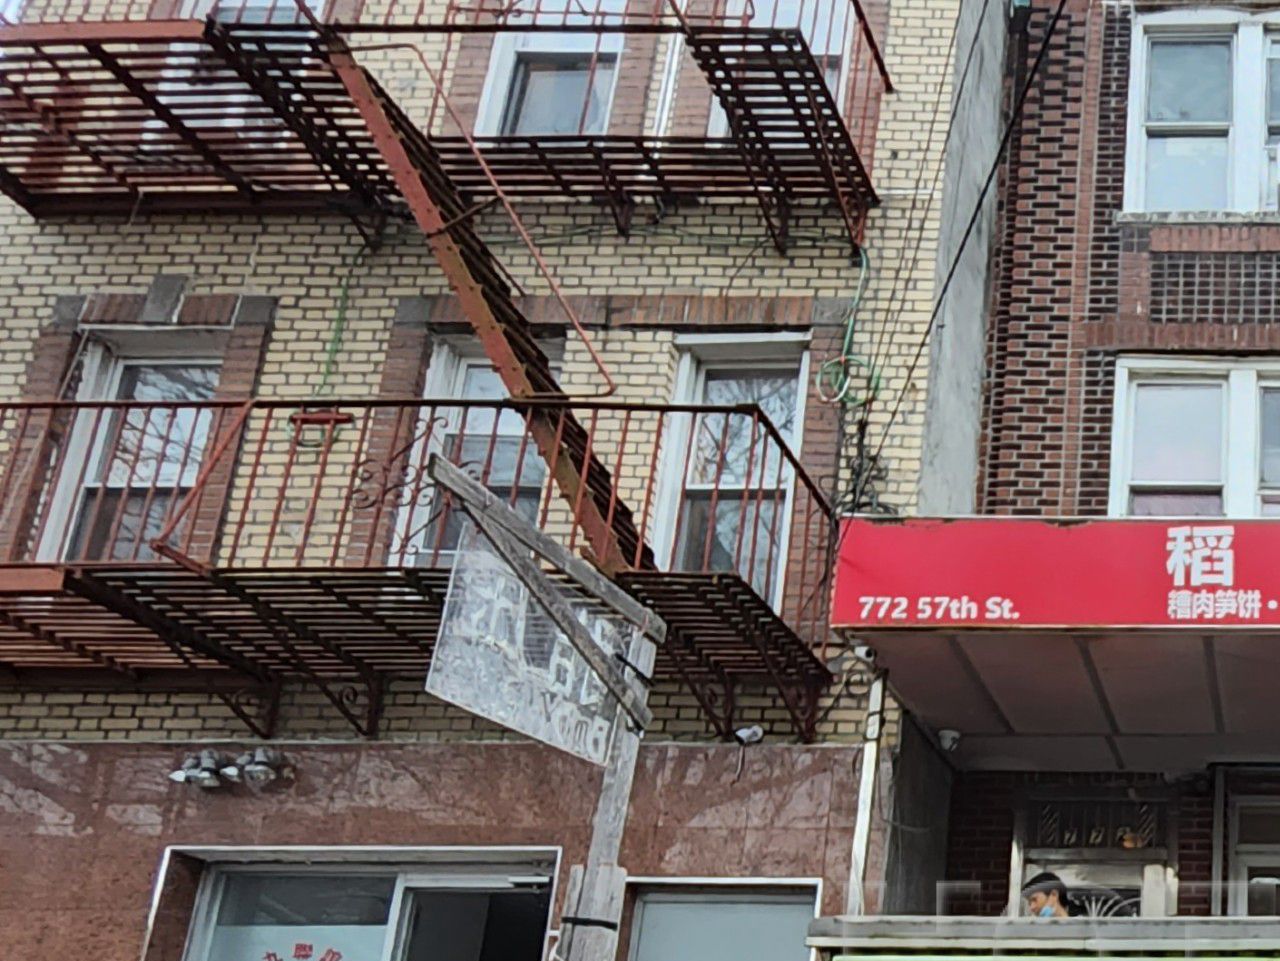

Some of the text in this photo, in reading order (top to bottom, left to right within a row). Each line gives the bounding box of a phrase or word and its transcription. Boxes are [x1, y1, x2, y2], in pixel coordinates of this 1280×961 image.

[859, 595, 1020, 619] 772 57th St.
